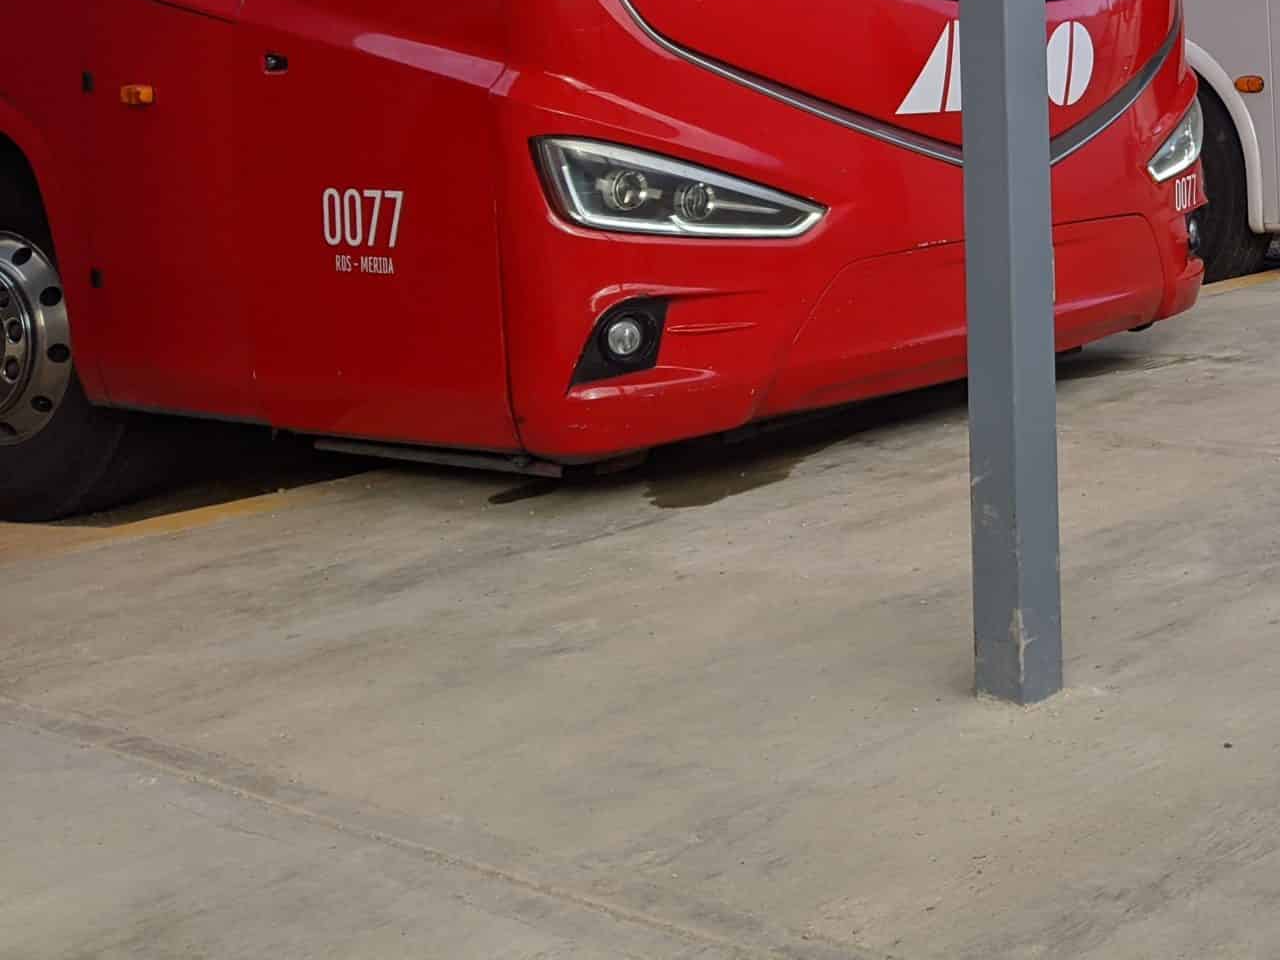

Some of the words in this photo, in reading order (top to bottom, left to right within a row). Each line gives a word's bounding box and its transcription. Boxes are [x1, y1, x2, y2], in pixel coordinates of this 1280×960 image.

[1175, 173, 1197, 211] 0077
[322, 187, 404, 248] 0077
[360, 256, 394, 274] MERIDA
